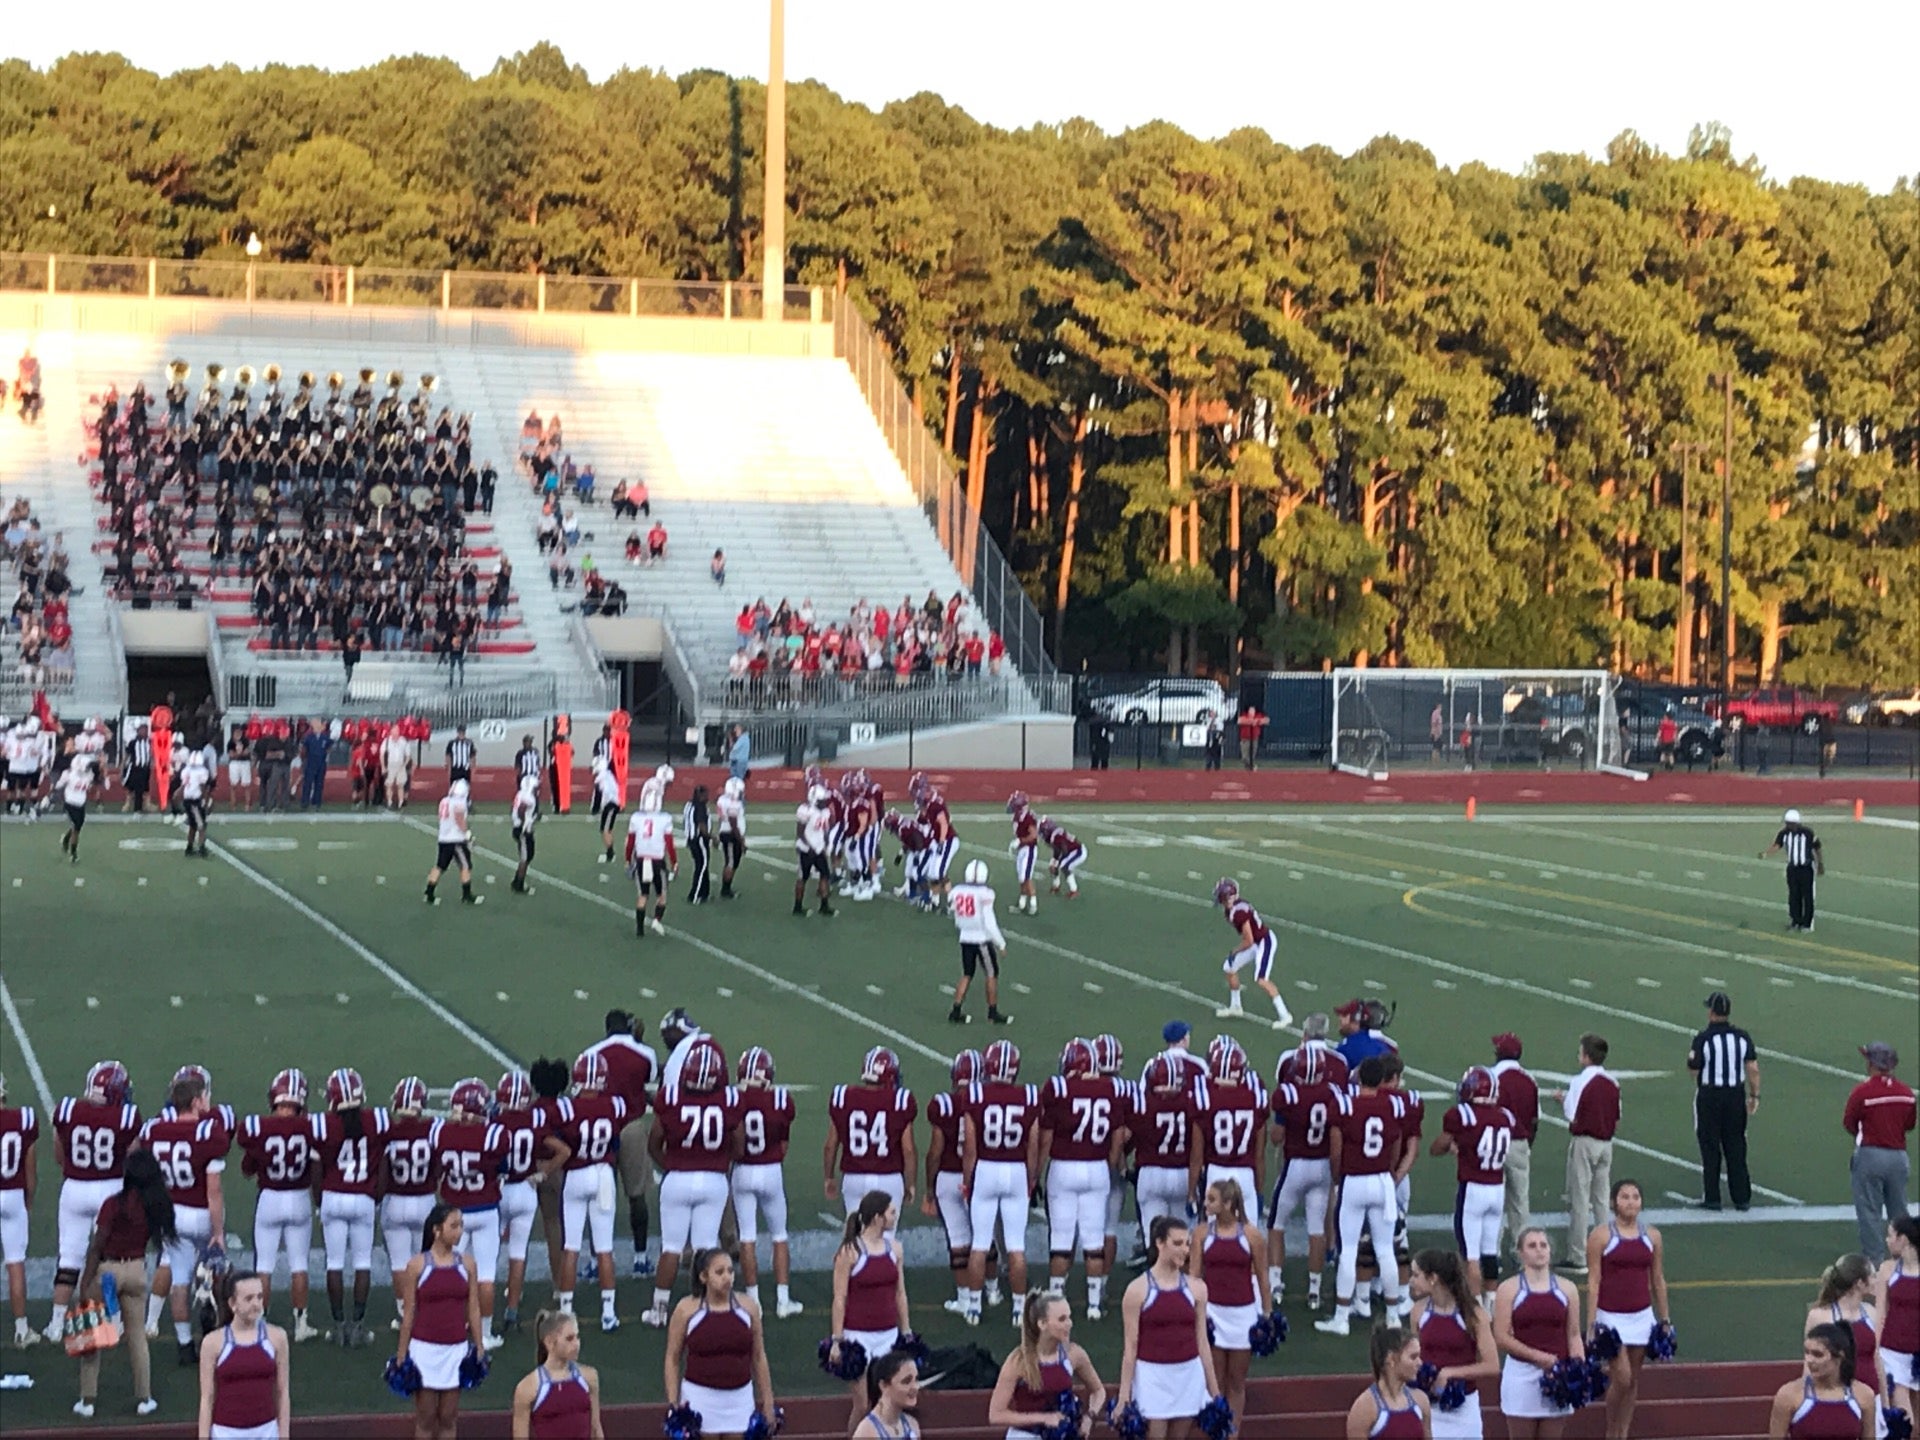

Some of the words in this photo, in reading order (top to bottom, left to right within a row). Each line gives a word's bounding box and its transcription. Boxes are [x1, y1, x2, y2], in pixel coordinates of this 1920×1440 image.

[482, 720, 504, 740] 20
[955, 893, 975, 917] 28
[578, 1118, 612, 1160] 18
[681, 1105, 724, 1150] 70
[745, 1110, 766, 1154] 9
[849, 1110, 888, 1157] 64
[983, 1104, 1025, 1148] 85
[1072, 1098, 1111, 1144] 76
[1156, 1111, 1186, 1154] 71
[1213, 1109, 1254, 1155] 87
[1307, 1103, 1328, 1146] 8
[1363, 1116, 1384, 1158] 6
[71, 1125, 115, 1170] 68
[152, 1141, 196, 1189] 56
[265, 1134, 308, 1181] 33
[337, 1136, 368, 1183] 41
[389, 1138, 431, 1185] 58
[508, 1128, 534, 1173] 0
[1477, 1125, 1511, 1171] 40
[441, 1150, 485, 1191] 35
